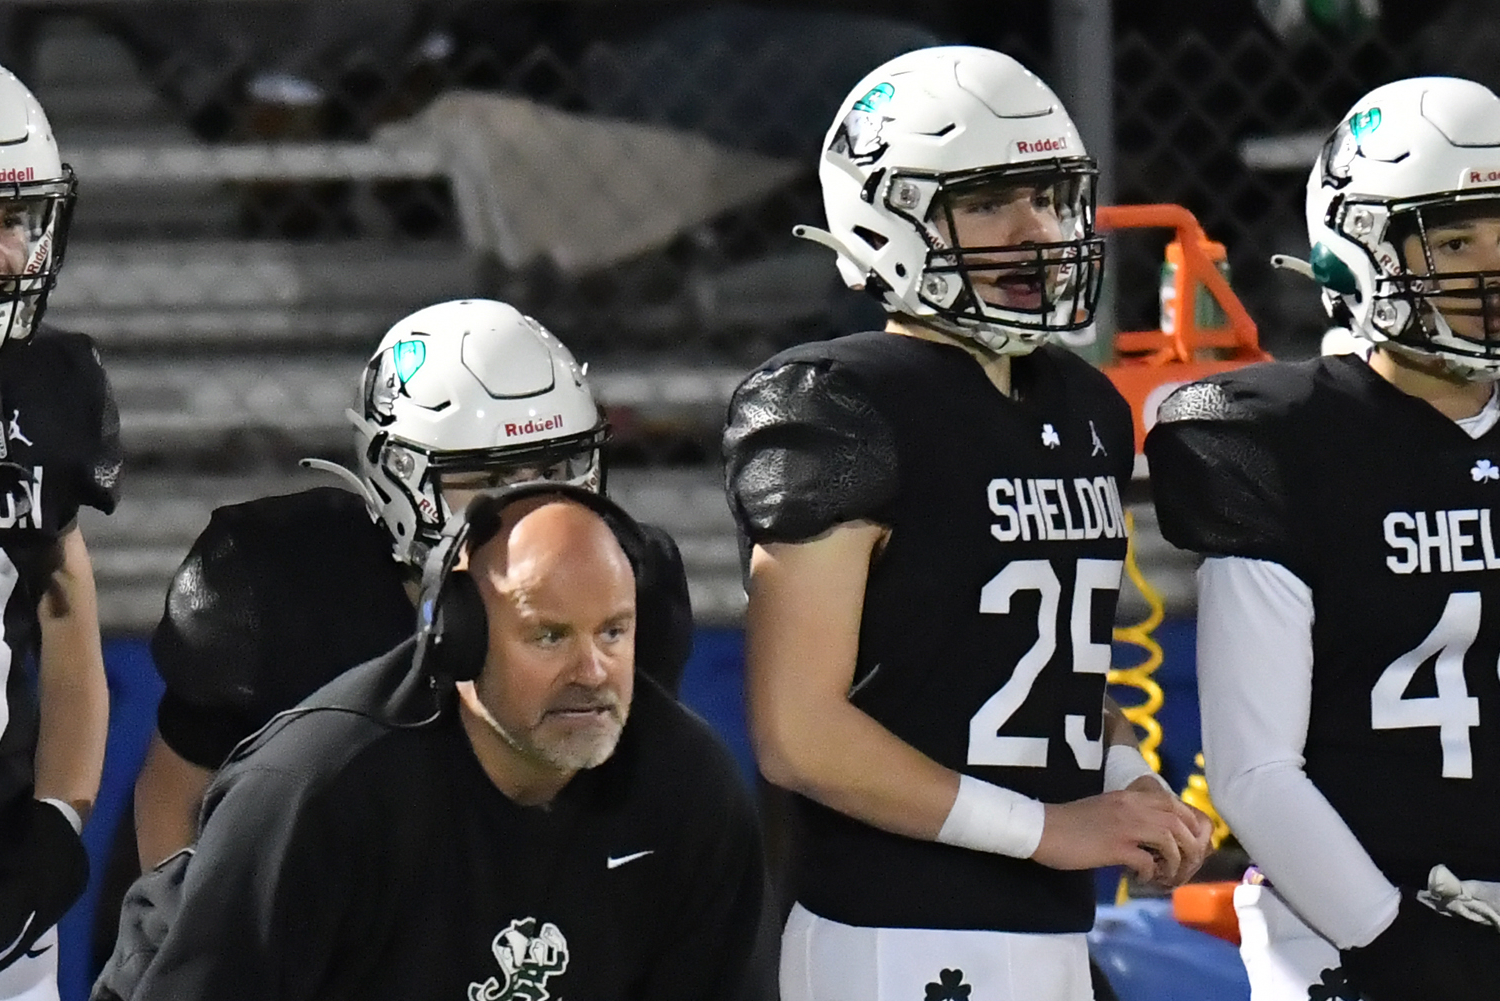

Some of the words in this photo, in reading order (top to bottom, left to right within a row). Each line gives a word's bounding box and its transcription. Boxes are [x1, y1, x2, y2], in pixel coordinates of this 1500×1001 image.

[504, 414, 563, 437] Riddell
[987, 475, 1128, 542] SHELDON
[1383, 508, 1500, 574] SHEL
[967, 558, 1124, 771] 25
[1371, 591, 1500, 779] 4
